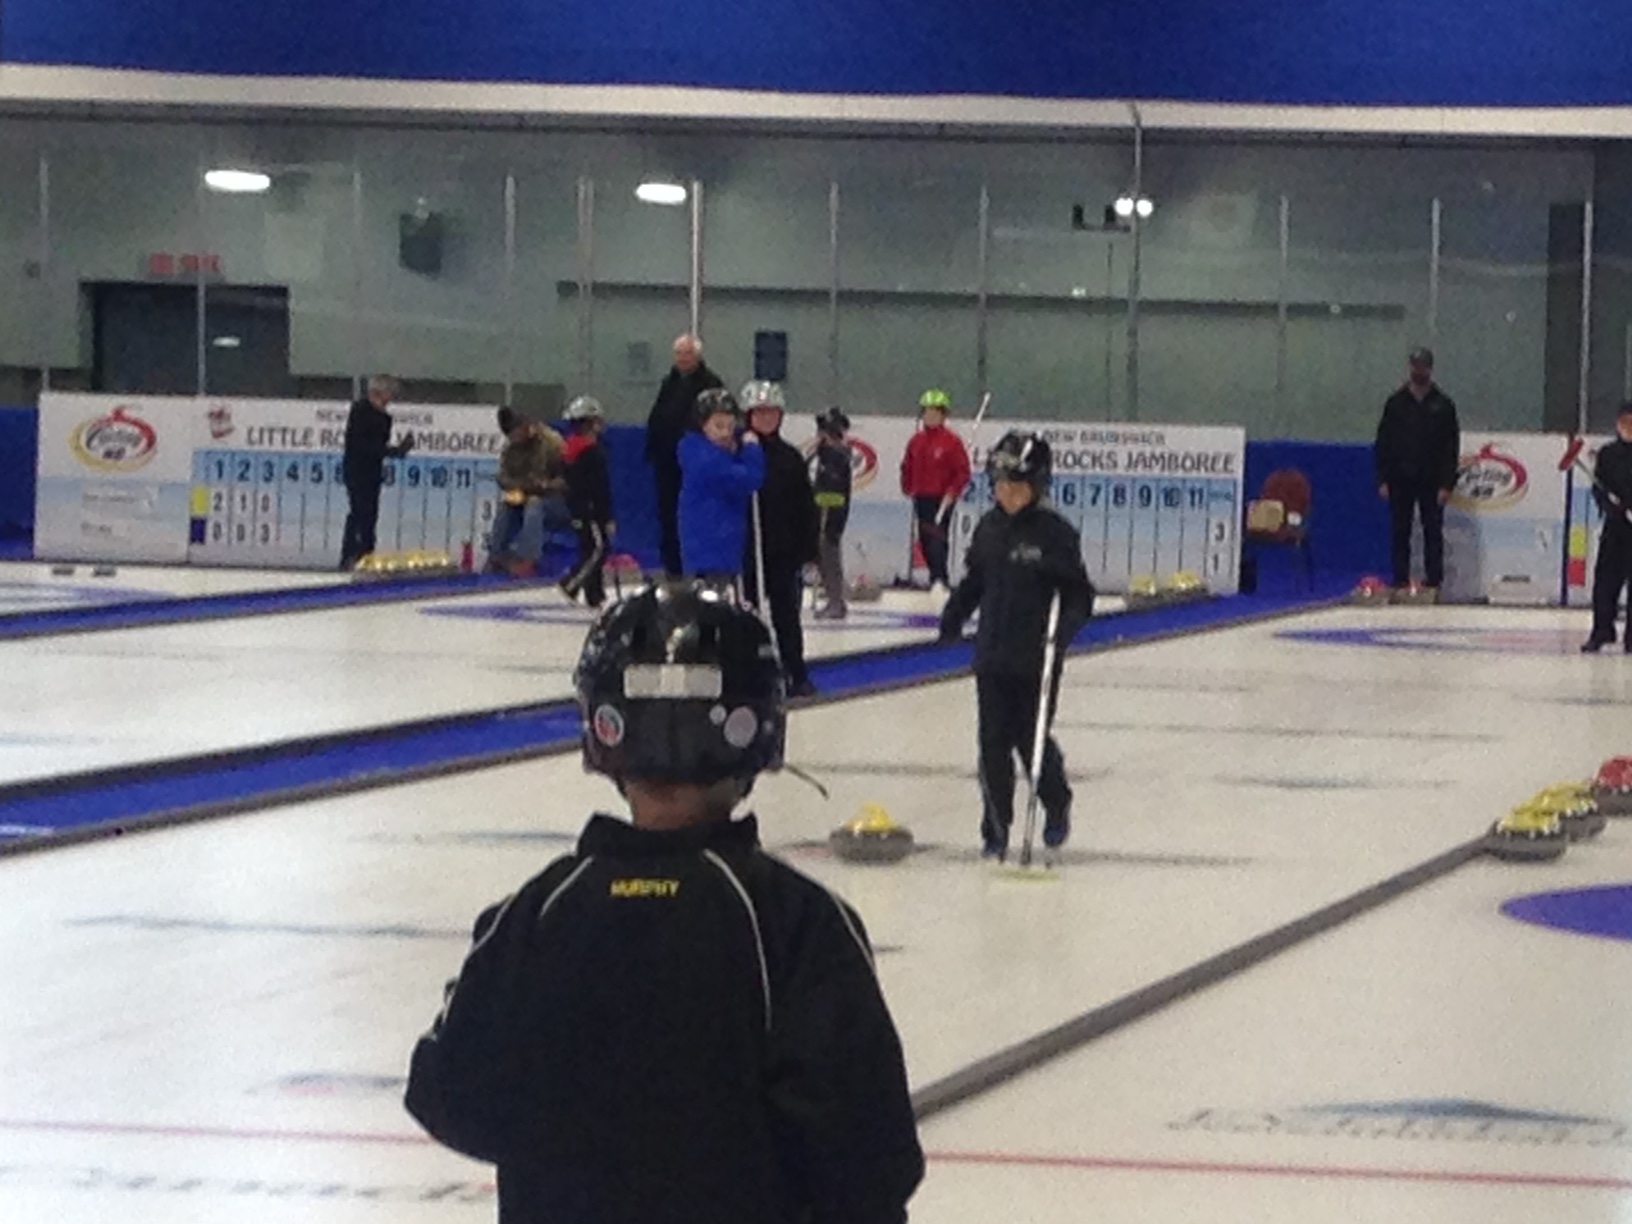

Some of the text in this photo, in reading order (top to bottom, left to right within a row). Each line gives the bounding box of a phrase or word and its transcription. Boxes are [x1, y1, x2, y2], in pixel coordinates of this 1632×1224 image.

[247, 426, 315, 448] LITTLE
[1053, 449, 1235, 474] ROCKS JAMBOREE
[215, 460, 224, 479] 1
[237, 461, 251, 481] 2
[262, 461, 274, 482] 3
[286, 461, 300, 482] 4
[311, 462, 324, 483] 5
[408, 465, 420, 486] 9
[431, 466, 448, 487] 10
[456, 468, 471, 488] 11
[213, 492, 223, 511] 2
[1062, 483, 1076, 505] 6
[1089, 484, 1102, 506] 7
[1112, 485, 1126, 507] 8
[1138, 485, 1152, 507] 9
[1160, 487, 1180, 509] 10
[1189, 488, 1205, 510] 11
[1215, 522, 1225, 542] 3
